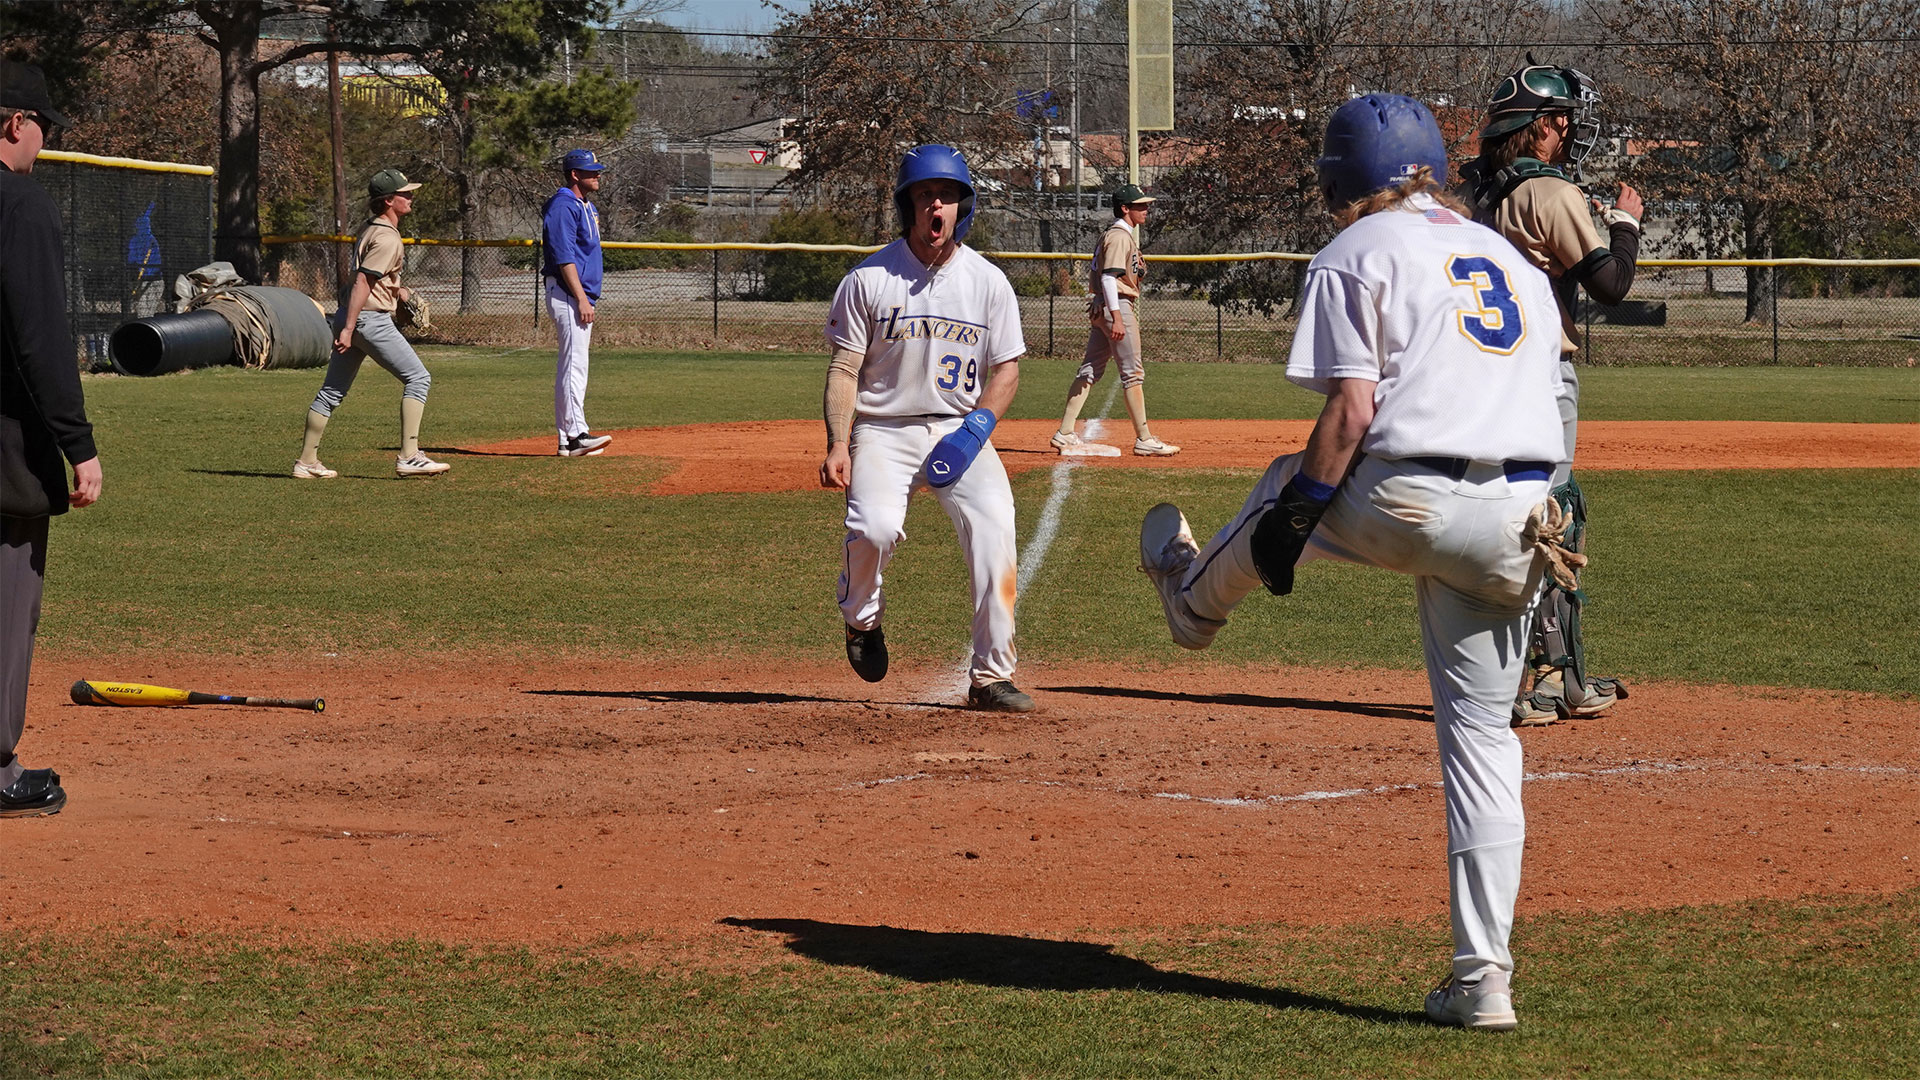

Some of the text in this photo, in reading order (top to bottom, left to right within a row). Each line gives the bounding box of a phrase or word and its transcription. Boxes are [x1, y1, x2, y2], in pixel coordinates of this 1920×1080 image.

[882, 305, 982, 346] LANCERS
[1444, 253, 1527, 356] 3
[935, 352, 978, 395] 39
[105, 686, 143, 695] EASTON
